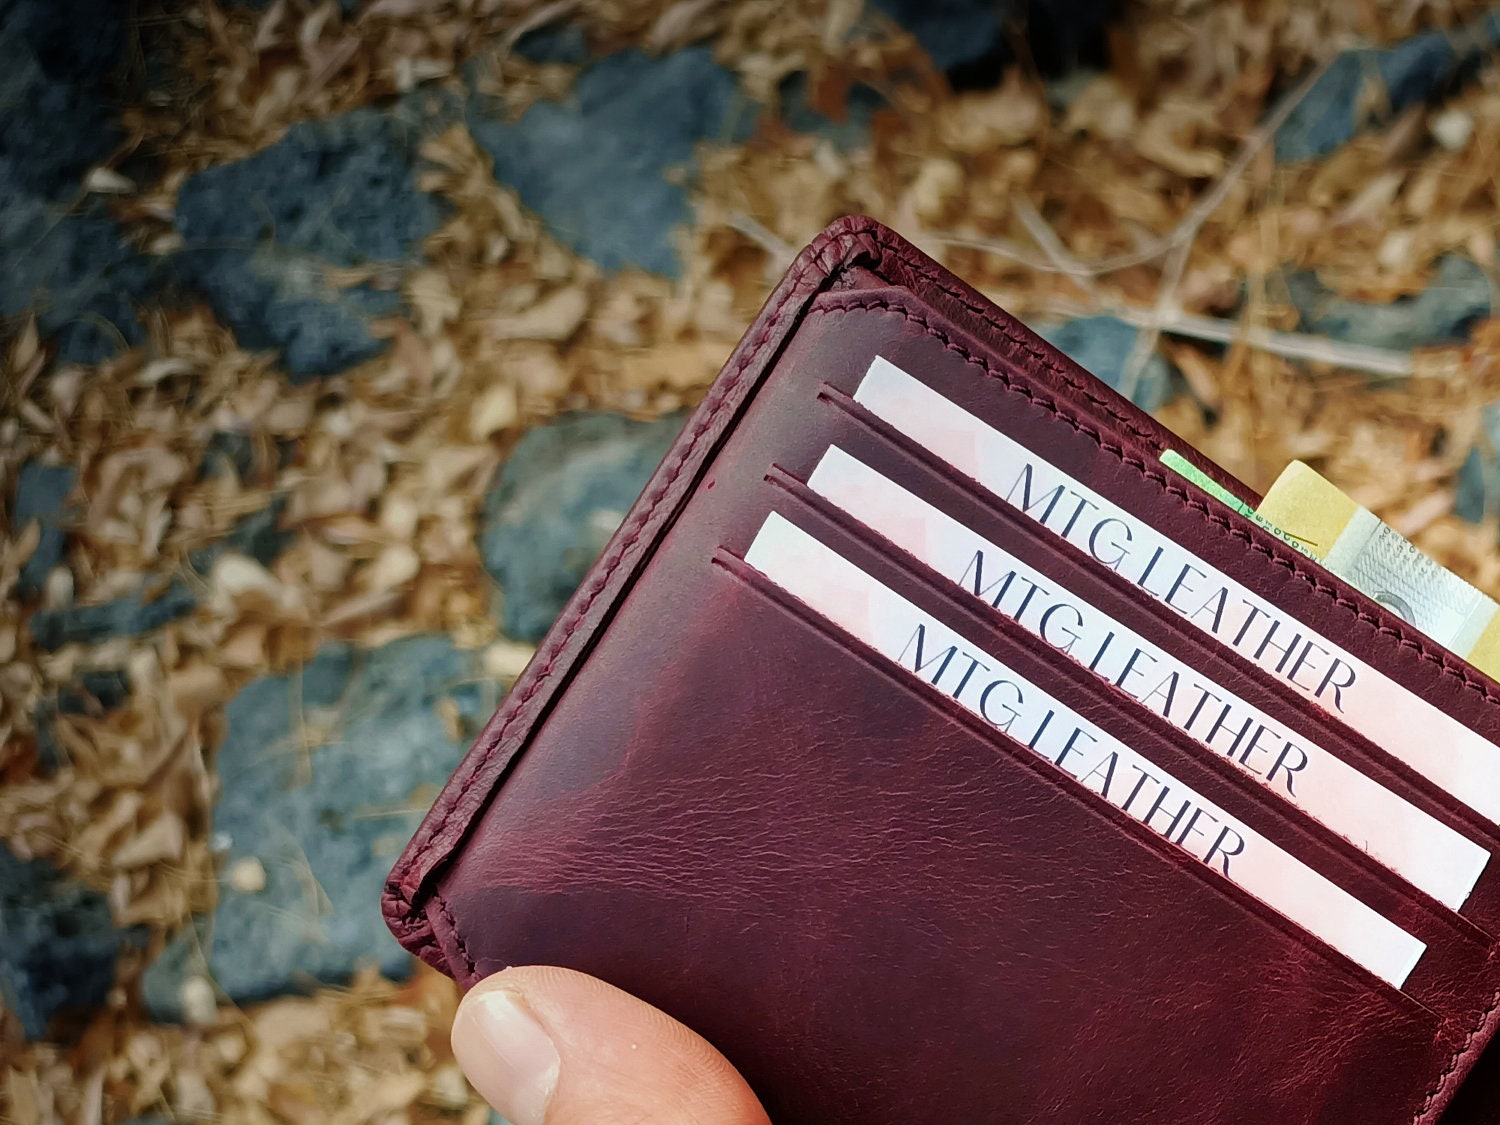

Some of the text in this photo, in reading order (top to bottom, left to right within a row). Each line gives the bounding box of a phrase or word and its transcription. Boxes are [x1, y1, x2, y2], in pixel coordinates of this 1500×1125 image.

[957, 549, 1309, 797] MTG LEATHER
[1003, 463, 1134, 571] MTG
[1136, 546, 1358, 714] LEATHER
[897, 623, 1245, 879] MTG LEATHER
